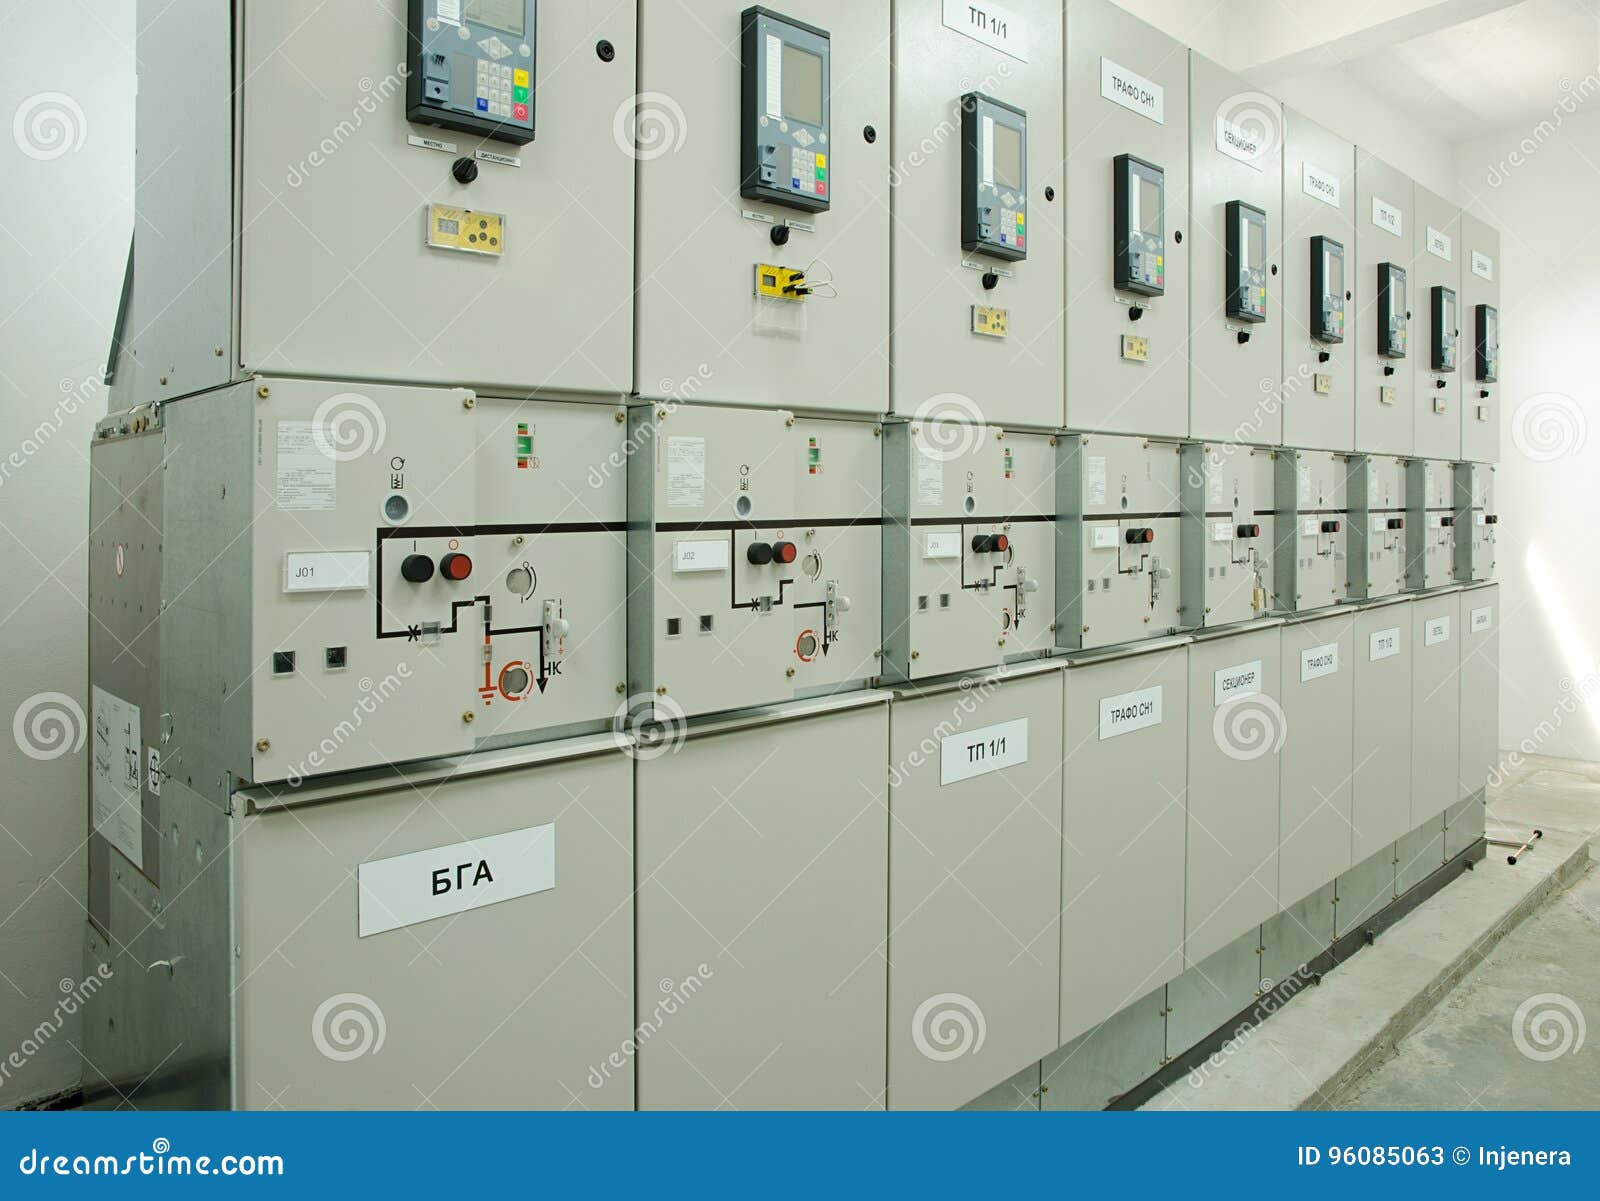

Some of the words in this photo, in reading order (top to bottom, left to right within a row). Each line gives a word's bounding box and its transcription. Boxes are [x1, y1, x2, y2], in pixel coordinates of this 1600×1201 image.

[968, 6, 986, 29] ТП
[990, 17, 1008, 39] 1/1
[1112, 75, 1139, 101] ТРАФО
[1140, 89, 1155, 108] СН1
[295, 567, 314, 578] J01
[1222, 672, 1255, 691] СЕКЦИОНЕР
[1110, 705, 1138, 724] ТРАФО
[1139, 701, 1153, 716] СН1
[967, 742, 985, 762] ТП
[989, 736, 1006, 757] 1/1
[432, 859, 494, 896] БГА
